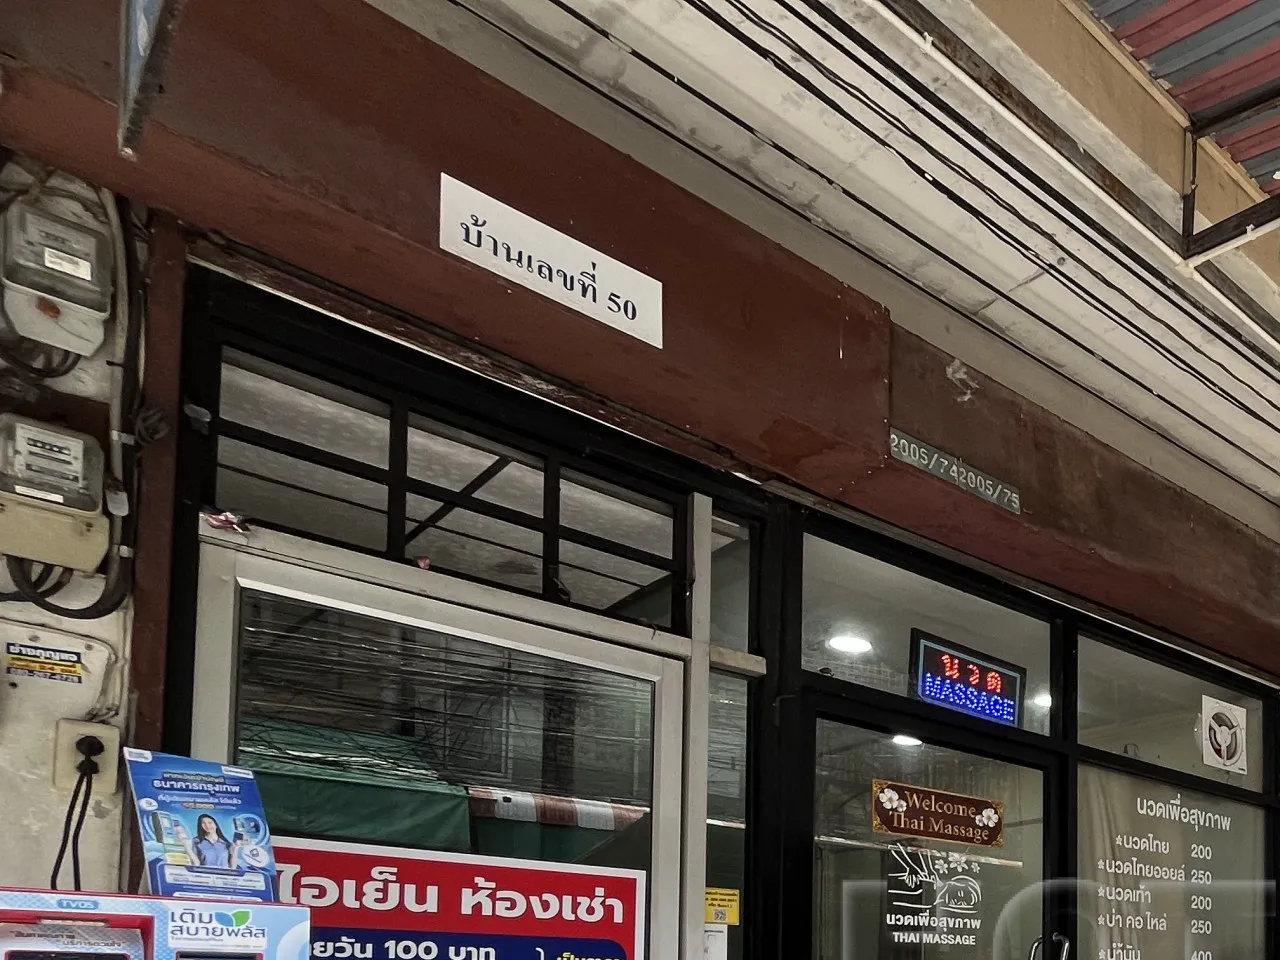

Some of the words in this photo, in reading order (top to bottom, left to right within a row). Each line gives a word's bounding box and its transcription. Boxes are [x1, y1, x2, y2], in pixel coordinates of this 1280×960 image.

[459, 214, 597, 304] บ้านเลขที่
[606, 292, 637, 320] 50
[958, 466, 1020, 508] 2005/75
[925, 672, 1014, 721] MASSAGE
[153, 780, 240, 794] ธนาคารกรุงเทพ
[904, 790, 976, 818] Welcome
[1136, 793, 1232, 832] นวดเพื่อสุขภาพ
[889, 810, 924, 831] Thai
[928, 817, 989, 843] Massage
[1123, 834, 1170, 854] นวดไทย
[1191, 844, 1212, 860] 200
[1106, 857, 1185, 882] นวดไทยออยล์
[1191, 869, 1212, 885] 250
[460, 875, 625, 923] ห้องเช่า
[1106, 884, 1151, 903] นวดเท้า
[1191, 895, 1212, 910] 200
[170, 908, 213, 924] เติม
[886, 910, 981, 932] นวดเพื่อสุขภาพ
[1106, 909, 1122, 928] บ่า
[1126, 915, 1143, 930] คอ
[1146, 912, 1168, 931] ไหล่
[1191, 919, 1212, 934] 250
[170, 925, 266, 938] สบายพลัส
[893, 931, 920, 944] THAI
[922, 932, 976, 945] MASSAGE
[310, 936, 373, 959] ยวัน
[384, 940, 438, 960] 100
